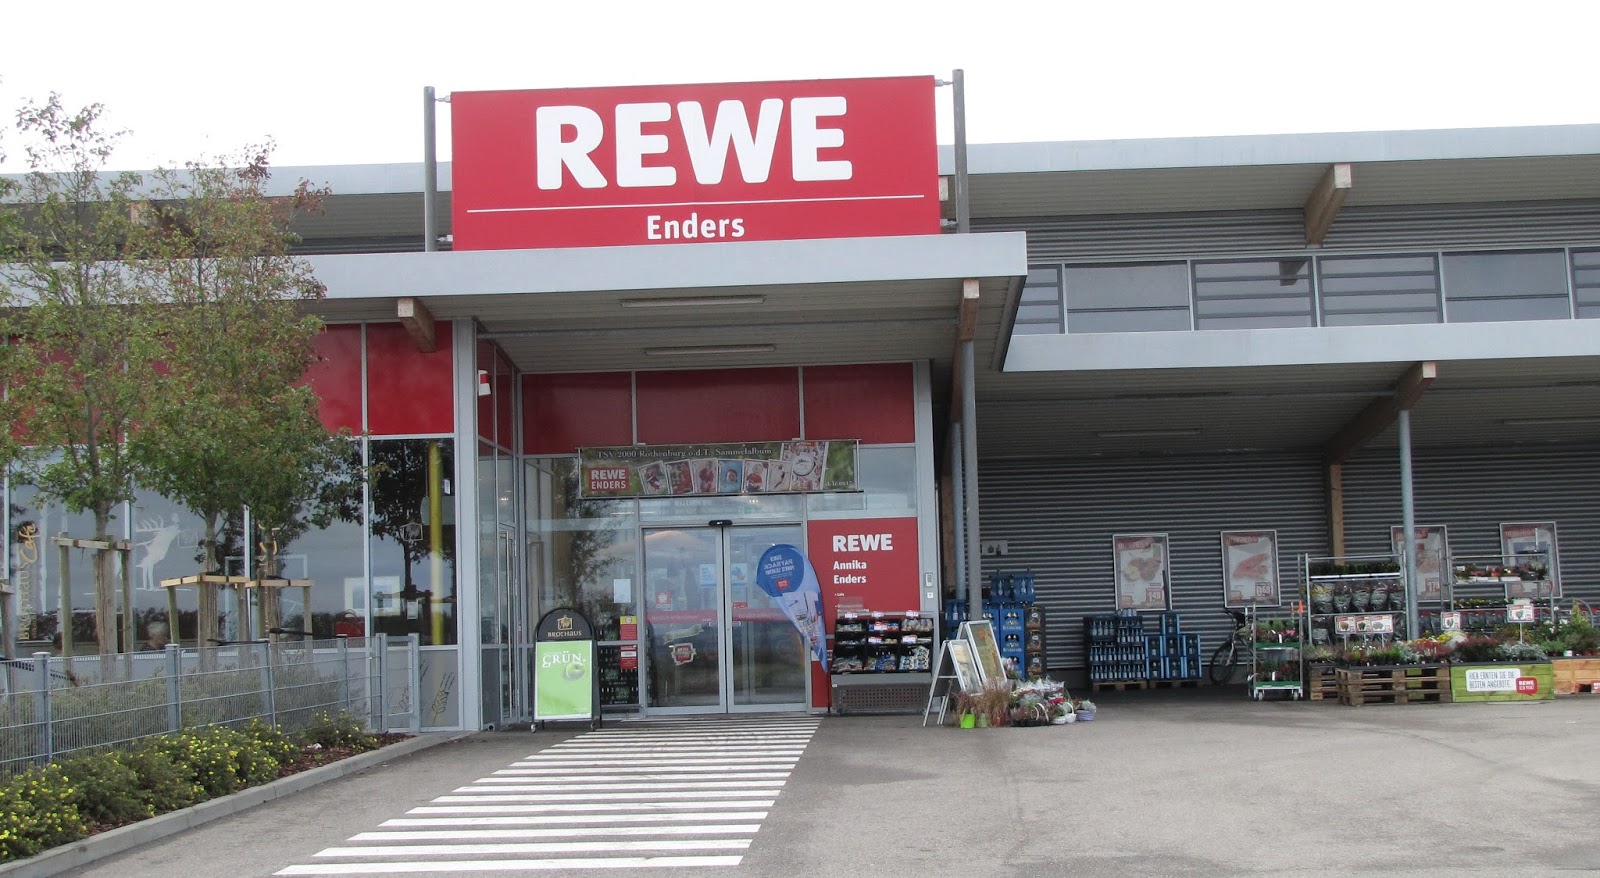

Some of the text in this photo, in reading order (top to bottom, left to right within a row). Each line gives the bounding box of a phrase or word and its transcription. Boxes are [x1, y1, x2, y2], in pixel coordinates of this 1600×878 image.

[536, 96, 852, 190] REWE
[647, 212, 745, 240] Enders
[597, 450, 617, 458] TSV
[618, 450, 637, 458] 2000
[640, 449, 686, 458] Rothenburg
[715, 448, 772, 456] Sammelalbum
[591, 469, 626, 480] REWE
[591, 480, 627, 490] ENDERS
[18, 524, 40, 563] Café
[832, 533, 894, 553] REWE
[833, 560, 867, 570] Annika
[833, 574, 867, 584] Enders
[1499, 671, 1507, 679] SIE
[1469, 680, 1486, 689] BESTEN
